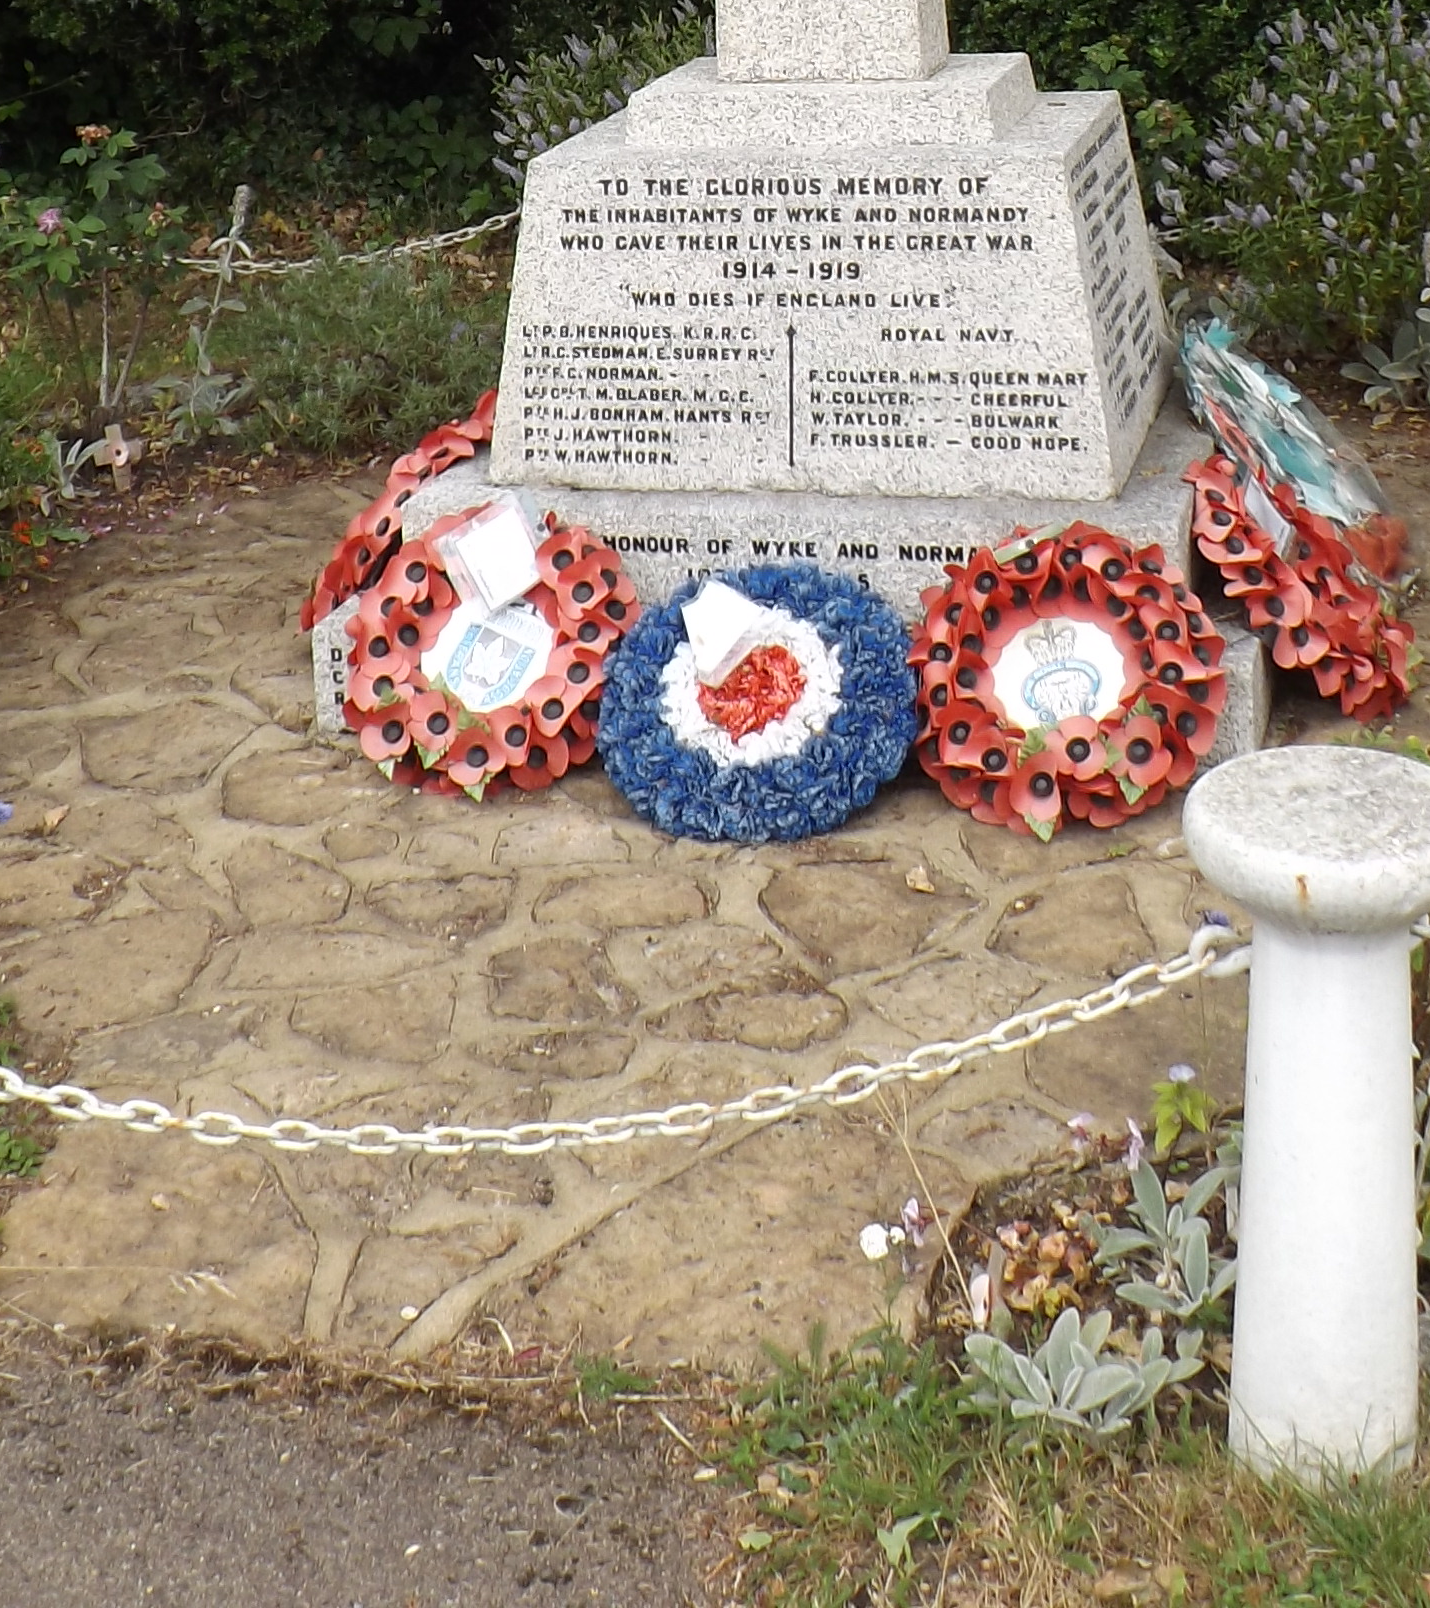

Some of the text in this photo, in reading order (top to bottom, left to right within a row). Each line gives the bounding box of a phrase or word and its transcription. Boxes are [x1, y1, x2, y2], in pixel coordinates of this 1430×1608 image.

[599, 177, 991, 197] TO THE GLORIOUS MEMORY OF
[562, 207, 1030, 224] THE INHABITANTS OF WYKE AND NORMANDY
[560, 235, 1034, 251] WHO GAVE THEIR LIVES IN THE GREAT WAR
[722, 262, 777, 279] 1914
[808, 262, 861, 280] 1919
[688, 292, 735, 307] DIES
[747, 292, 765, 307] IF
[776, 293, 876, 308] ENGLAND
[880, 327, 946, 342] ROYAL
[969, 371, 1030, 389] QUEEN
[1037, 372, 1088, 387] MARY
[971, 393, 1070, 407] CHEERFUL
[674, 409, 732, 423] HANTS
[971, 414, 1061, 428] BULWARK
[971, 436, 1022, 450] GOOD
[602, 536, 978, 563] HONOUR OF WYKE AND NORMA
